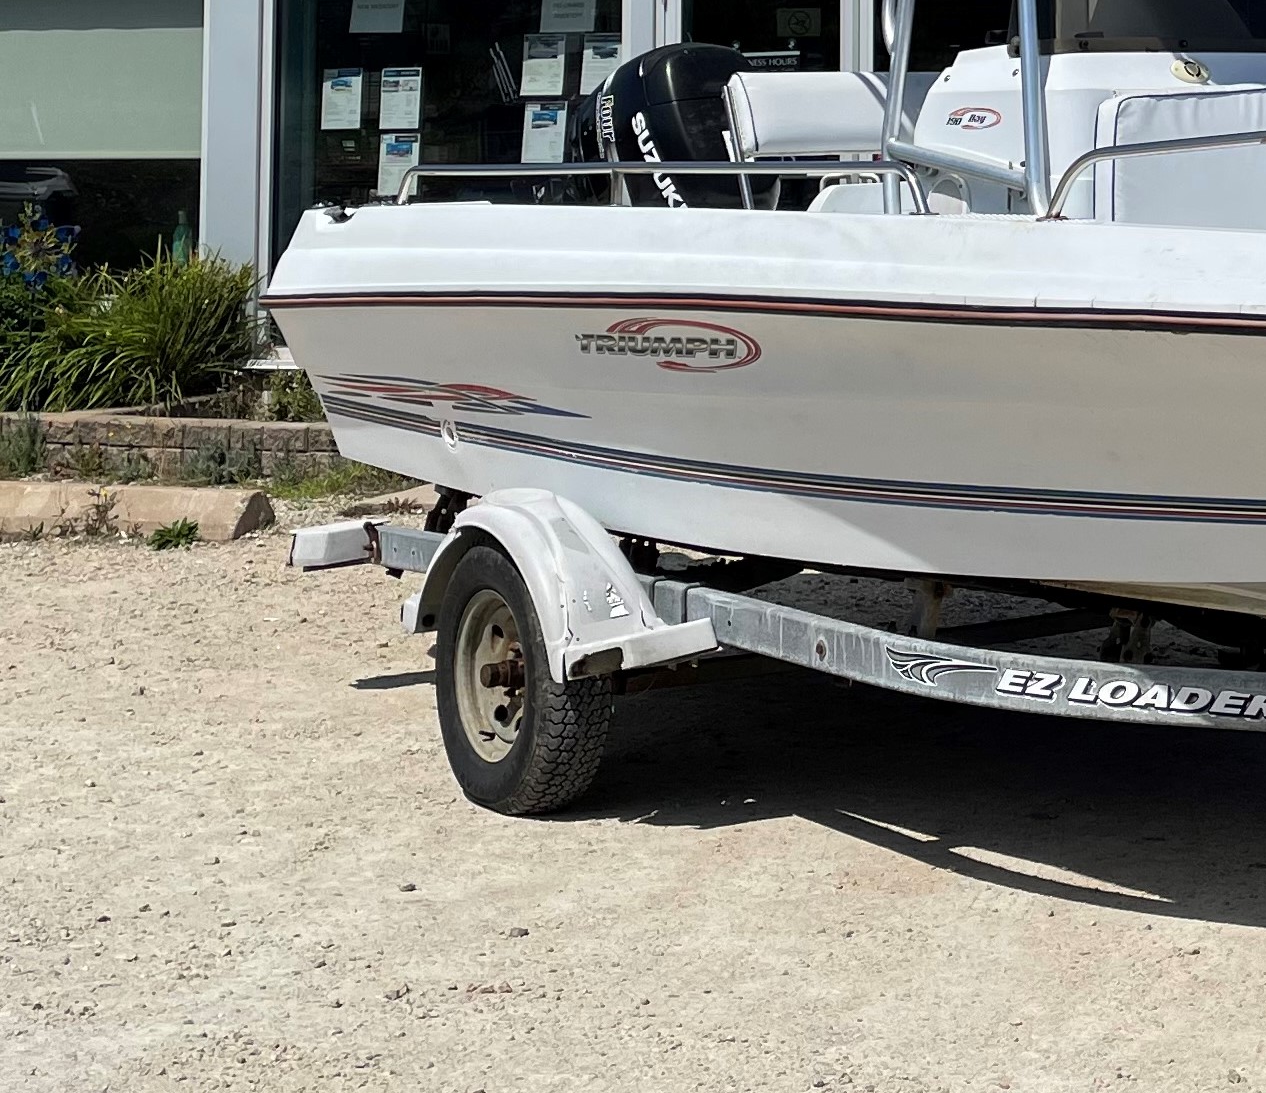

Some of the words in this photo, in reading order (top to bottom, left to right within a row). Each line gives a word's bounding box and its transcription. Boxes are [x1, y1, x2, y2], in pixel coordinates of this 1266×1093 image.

[768, 57, 798, 66] HOURS
[575, 333, 738, 359] TRIUMPH
[996, 668, 1065, 703] EZ
